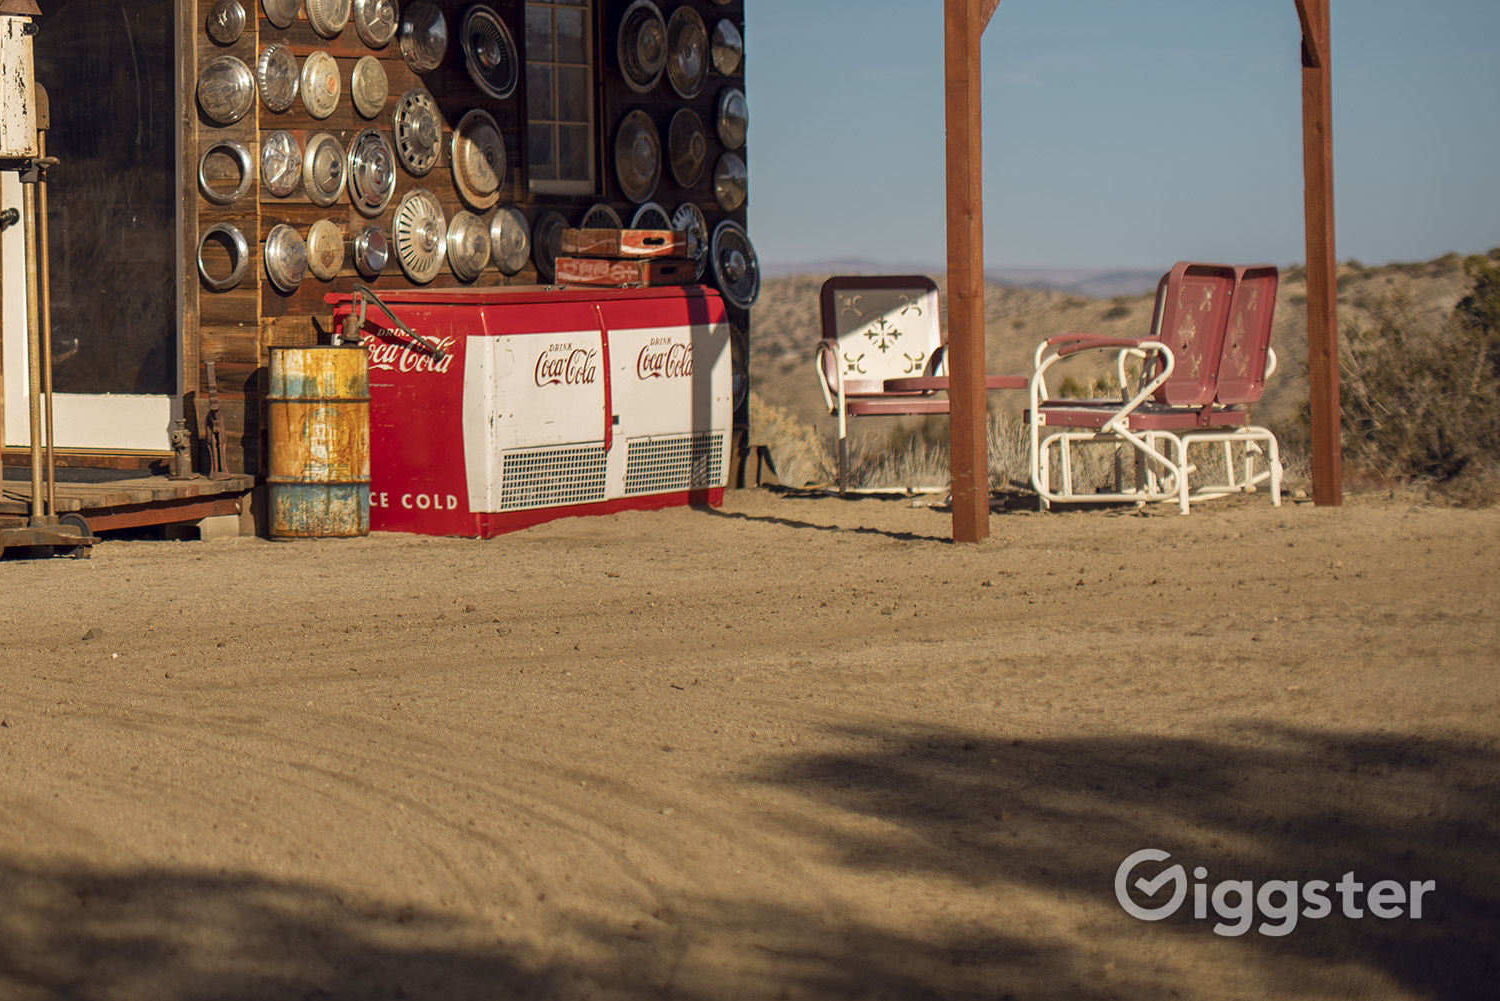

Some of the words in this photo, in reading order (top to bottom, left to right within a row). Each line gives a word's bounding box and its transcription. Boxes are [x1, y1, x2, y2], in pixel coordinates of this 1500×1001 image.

[376, 327, 417, 337] DRIN
[650, 337, 673, 346] DRINK
[549, 342, 572, 352] DRINK
[535, 348, 597, 387] Coca-Cola
[369, 491, 389, 508] CE
[401, 493, 458, 510] COLD
